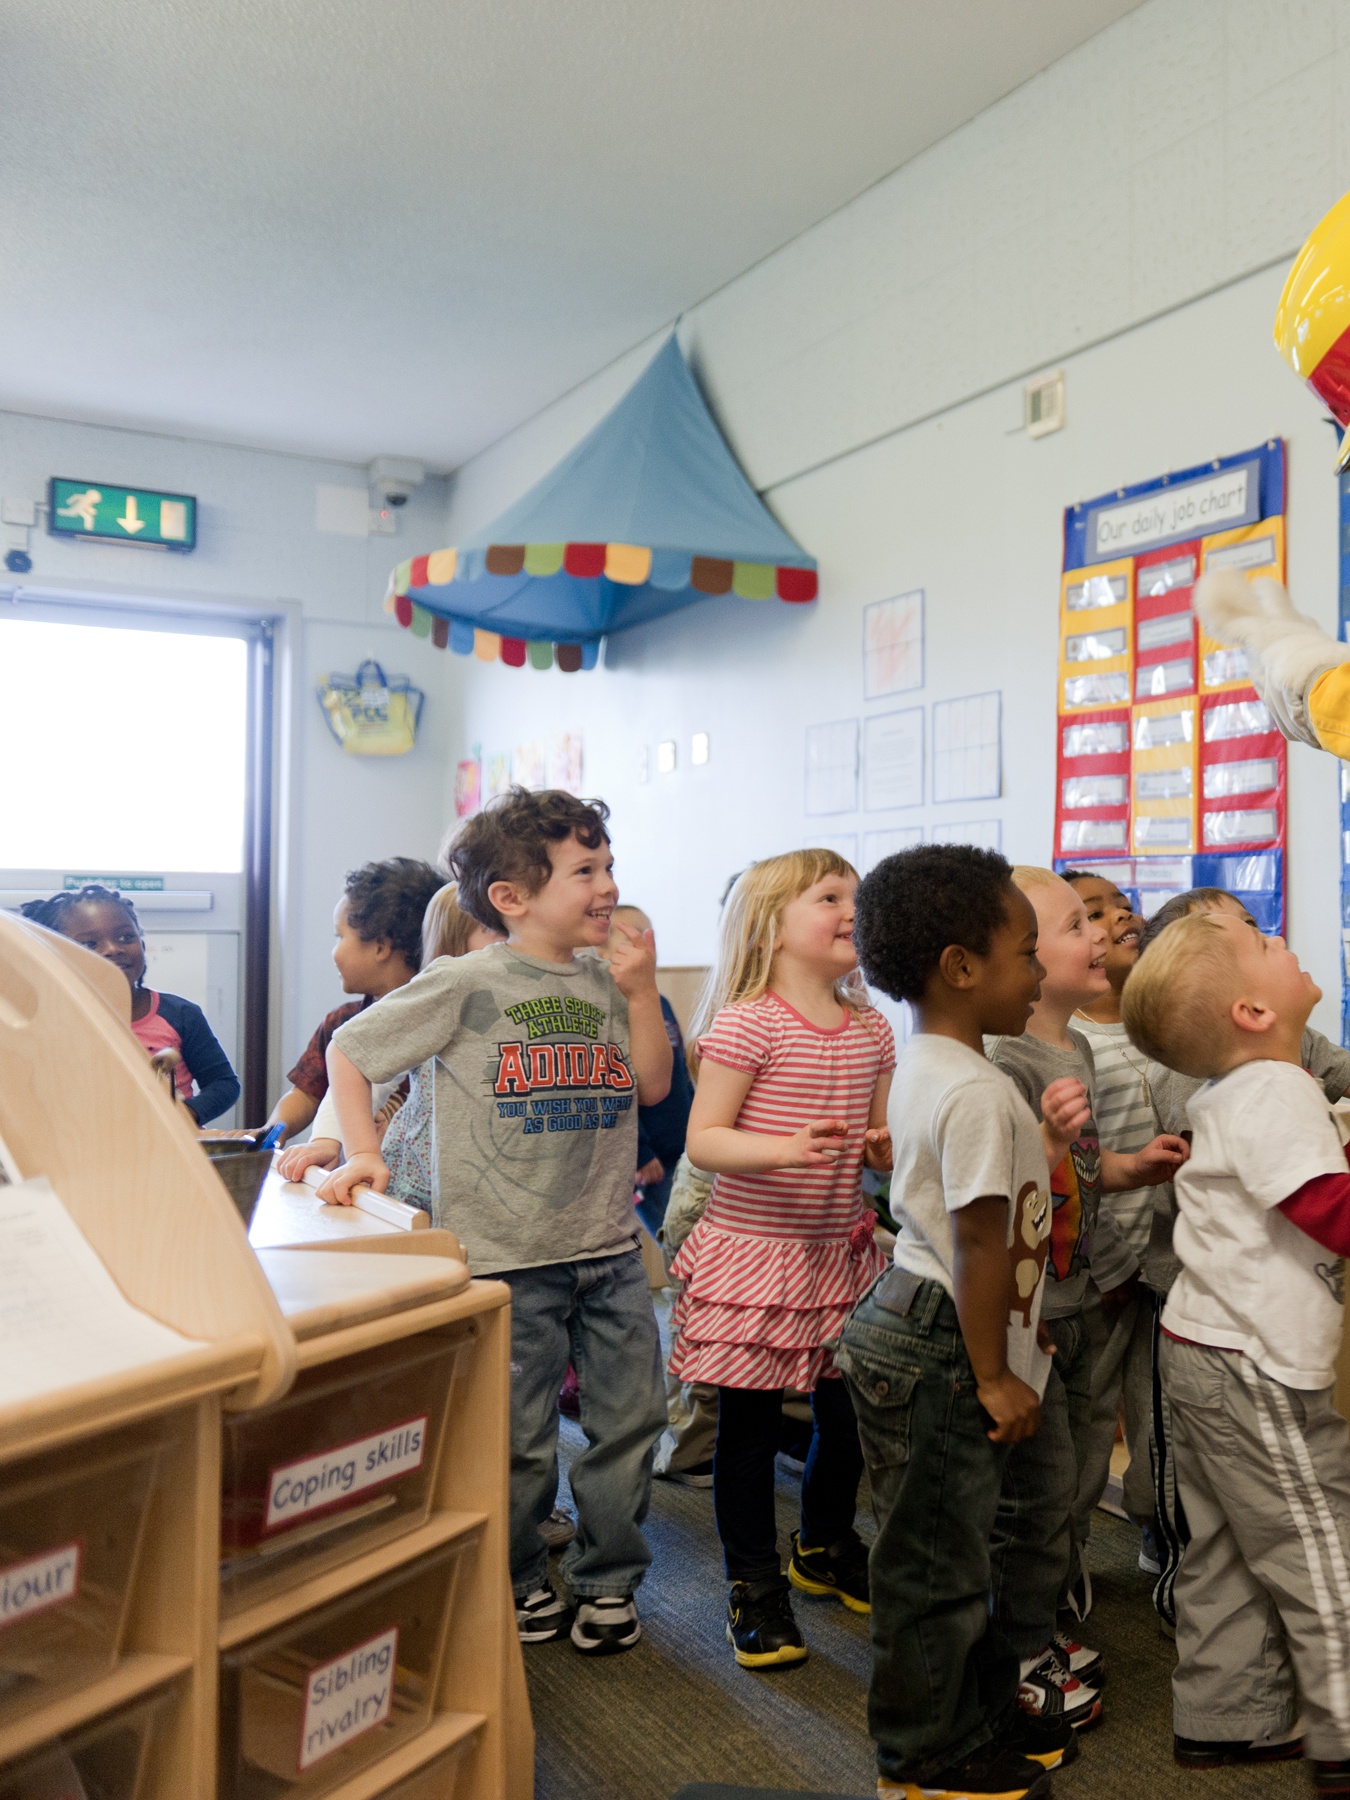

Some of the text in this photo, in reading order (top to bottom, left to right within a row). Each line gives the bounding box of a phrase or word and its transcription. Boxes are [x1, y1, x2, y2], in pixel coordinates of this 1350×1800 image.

[1099, 482, 1244, 543] Our daily job chart
[505, 996, 606, 1026] THREE SPORT
[526, 1015, 599, 1040] ATHLETE
[494, 1040, 634, 1097] ADIDAS
[497, 1095, 633, 1118] YOU WISH YOU WERE
[523, 1112, 618, 1134] AS GOOD AS ME
[273, 1429, 421, 1510] Coping skills
[310, 1644, 391, 1706] Sibling
[307, 1687, 387, 1753] rivalry
